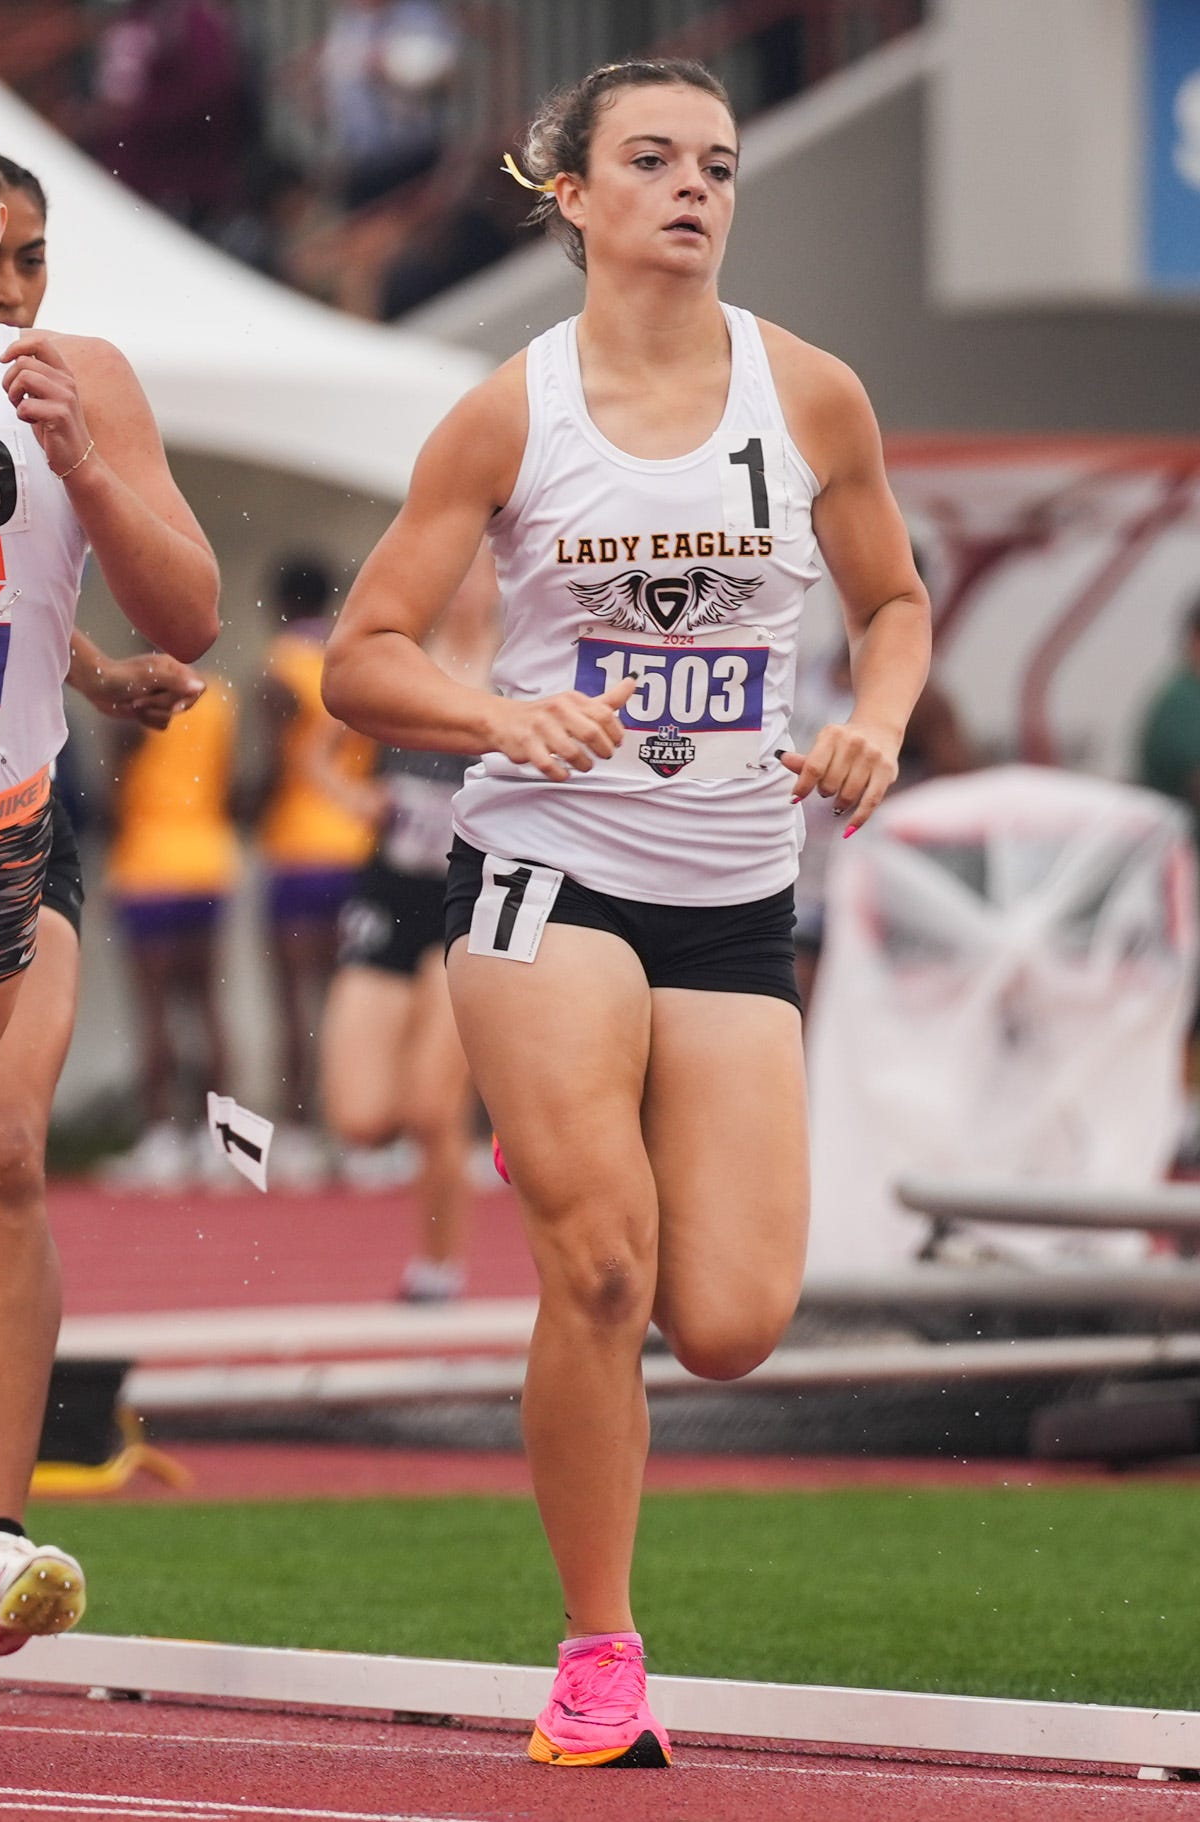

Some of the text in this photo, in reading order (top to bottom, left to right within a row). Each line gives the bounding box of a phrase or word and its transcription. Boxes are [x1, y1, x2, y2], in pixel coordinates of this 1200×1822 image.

[728, 438, 770, 528] 1
[556, 532, 773, 564] LADY EAGLES
[663, 634, 695, 645] 2024
[595, 650, 749, 724] 1503
[640, 745, 695, 760] STATE
[493, 866, 532, 951] 1
